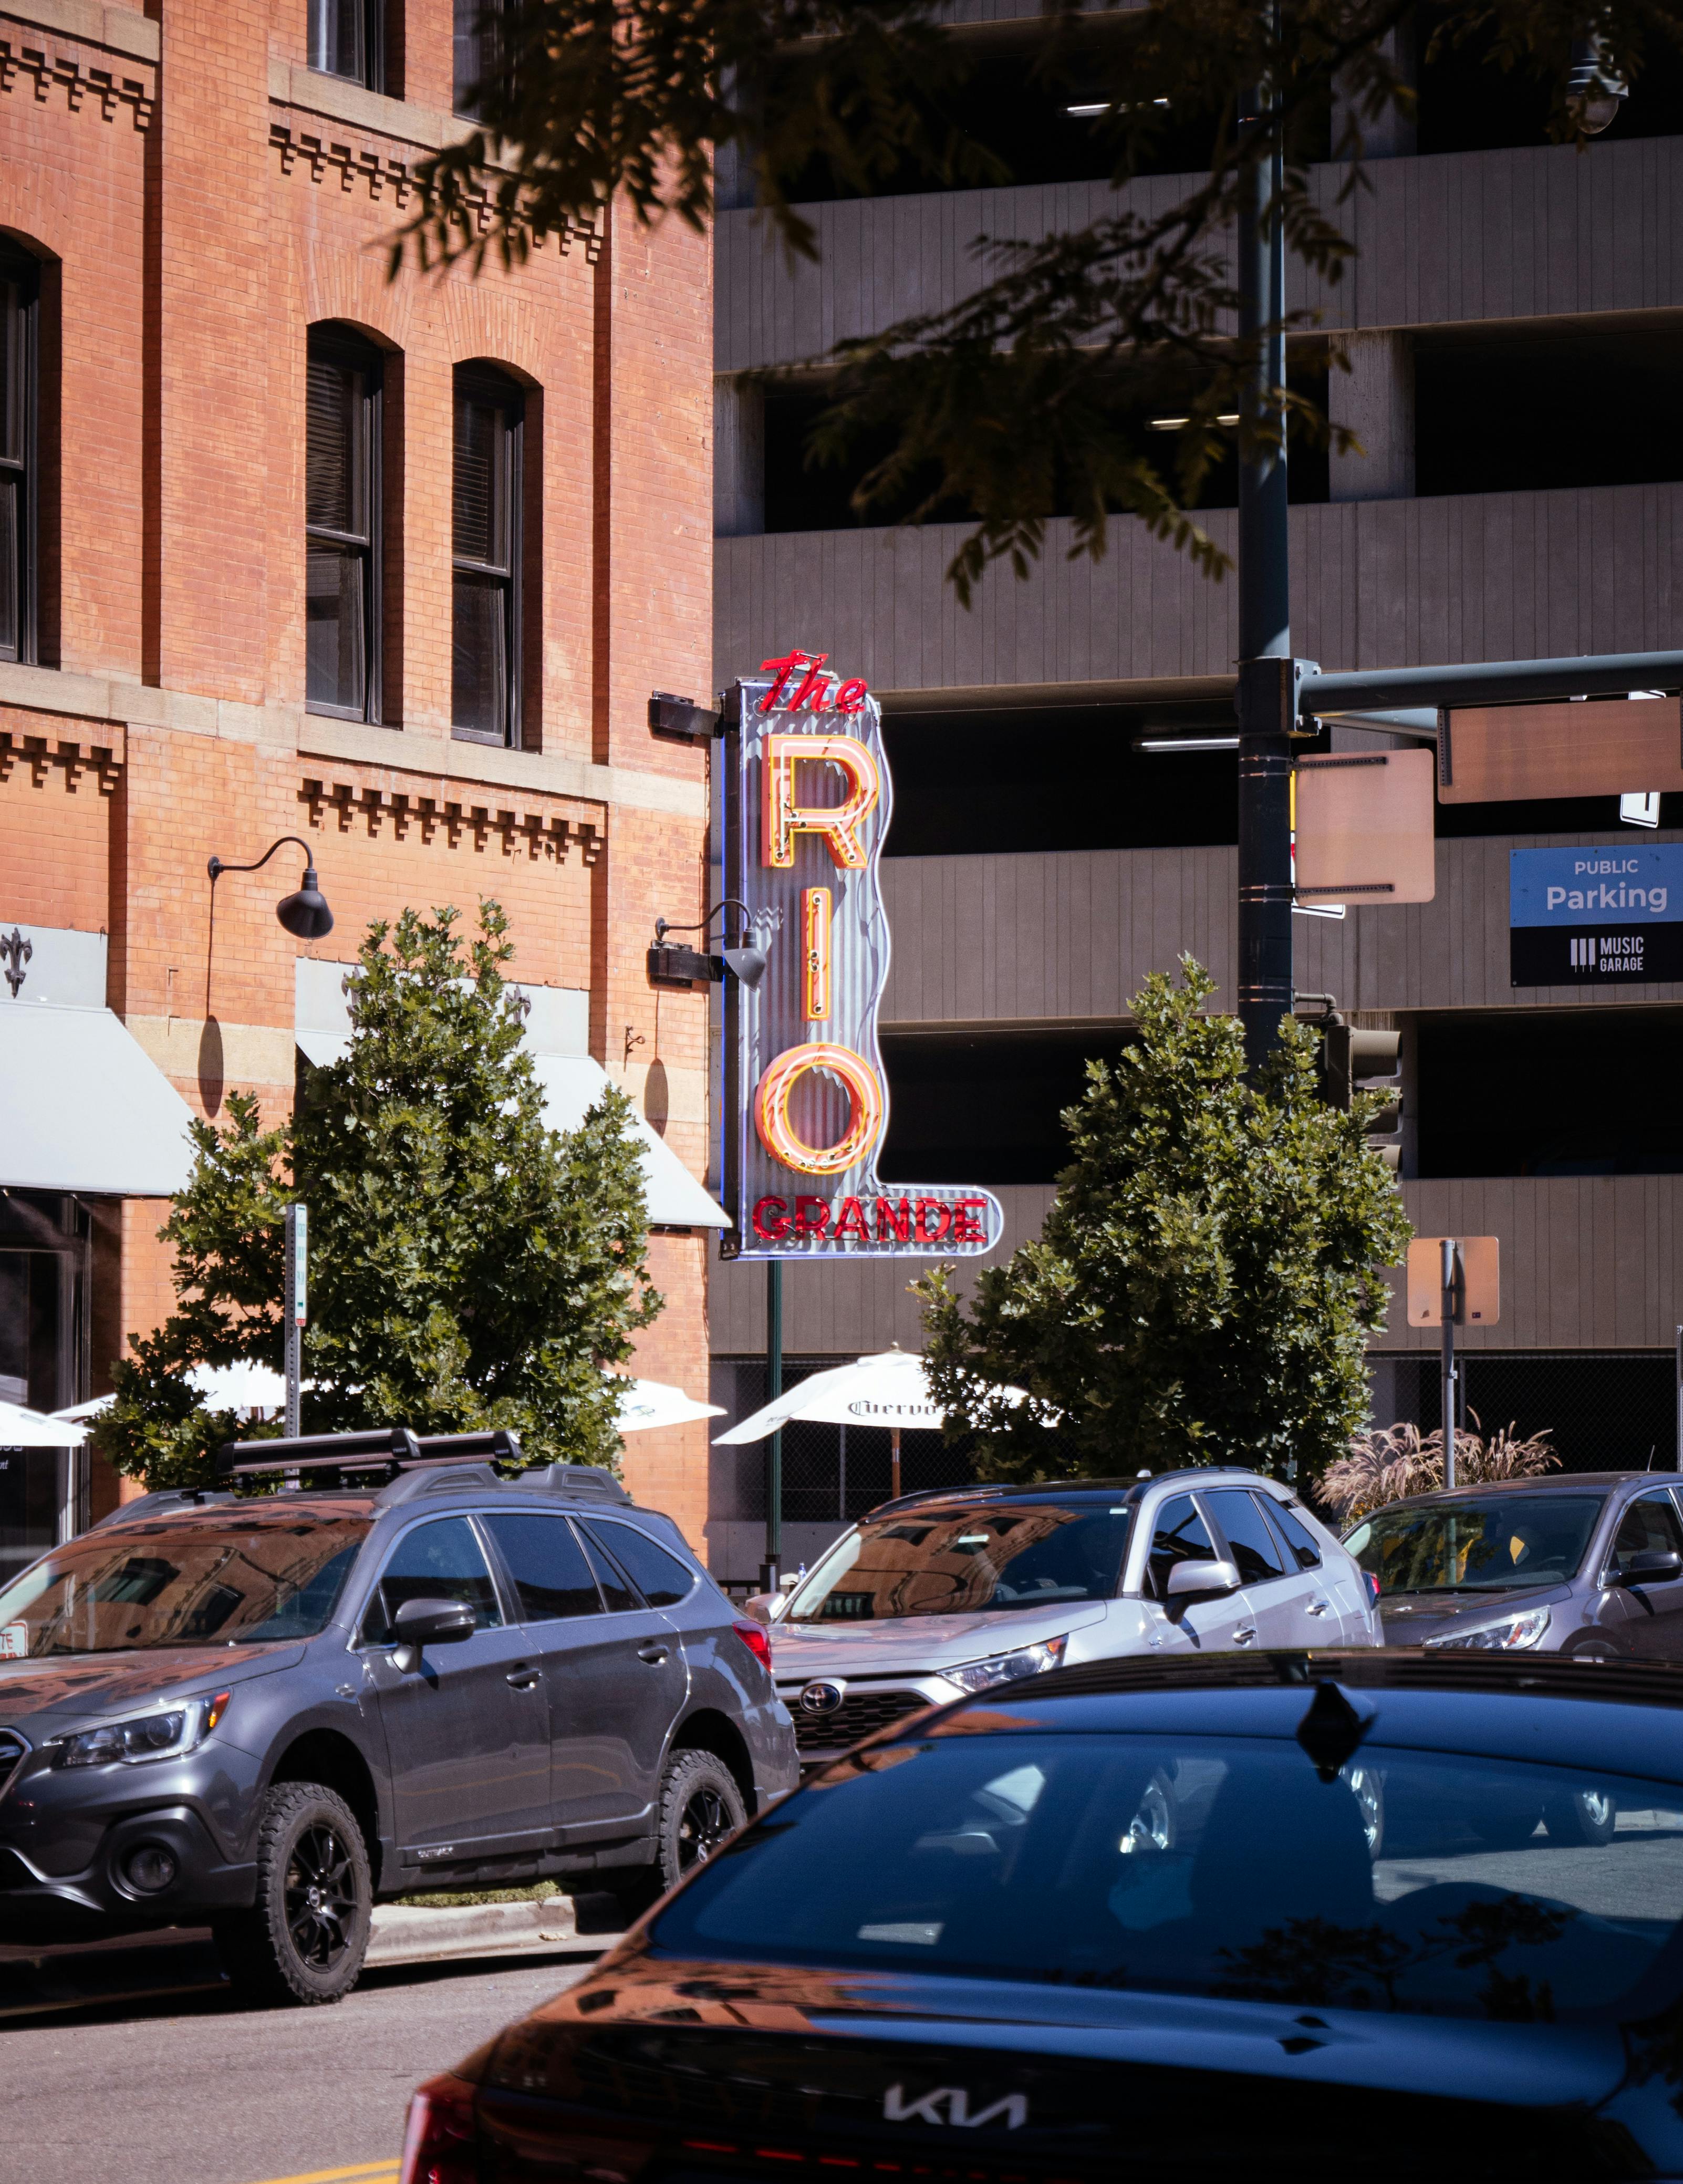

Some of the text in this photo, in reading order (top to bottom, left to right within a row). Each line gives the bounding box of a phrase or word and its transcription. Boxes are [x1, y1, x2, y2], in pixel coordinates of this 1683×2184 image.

[760, 650, 868, 713] The
[1574, 859, 1639, 875] PUBLIC
[1546, 882, 1668, 913] Parking
[754, 733, 882, 1175] RIO
[1599, 936, 1644, 955] MUSIC
[1599, 957, 1644, 972] GARAGE
[752, 1195, 988, 1243] GRANDE
[848, 1400, 937, 1416] Cuervo
